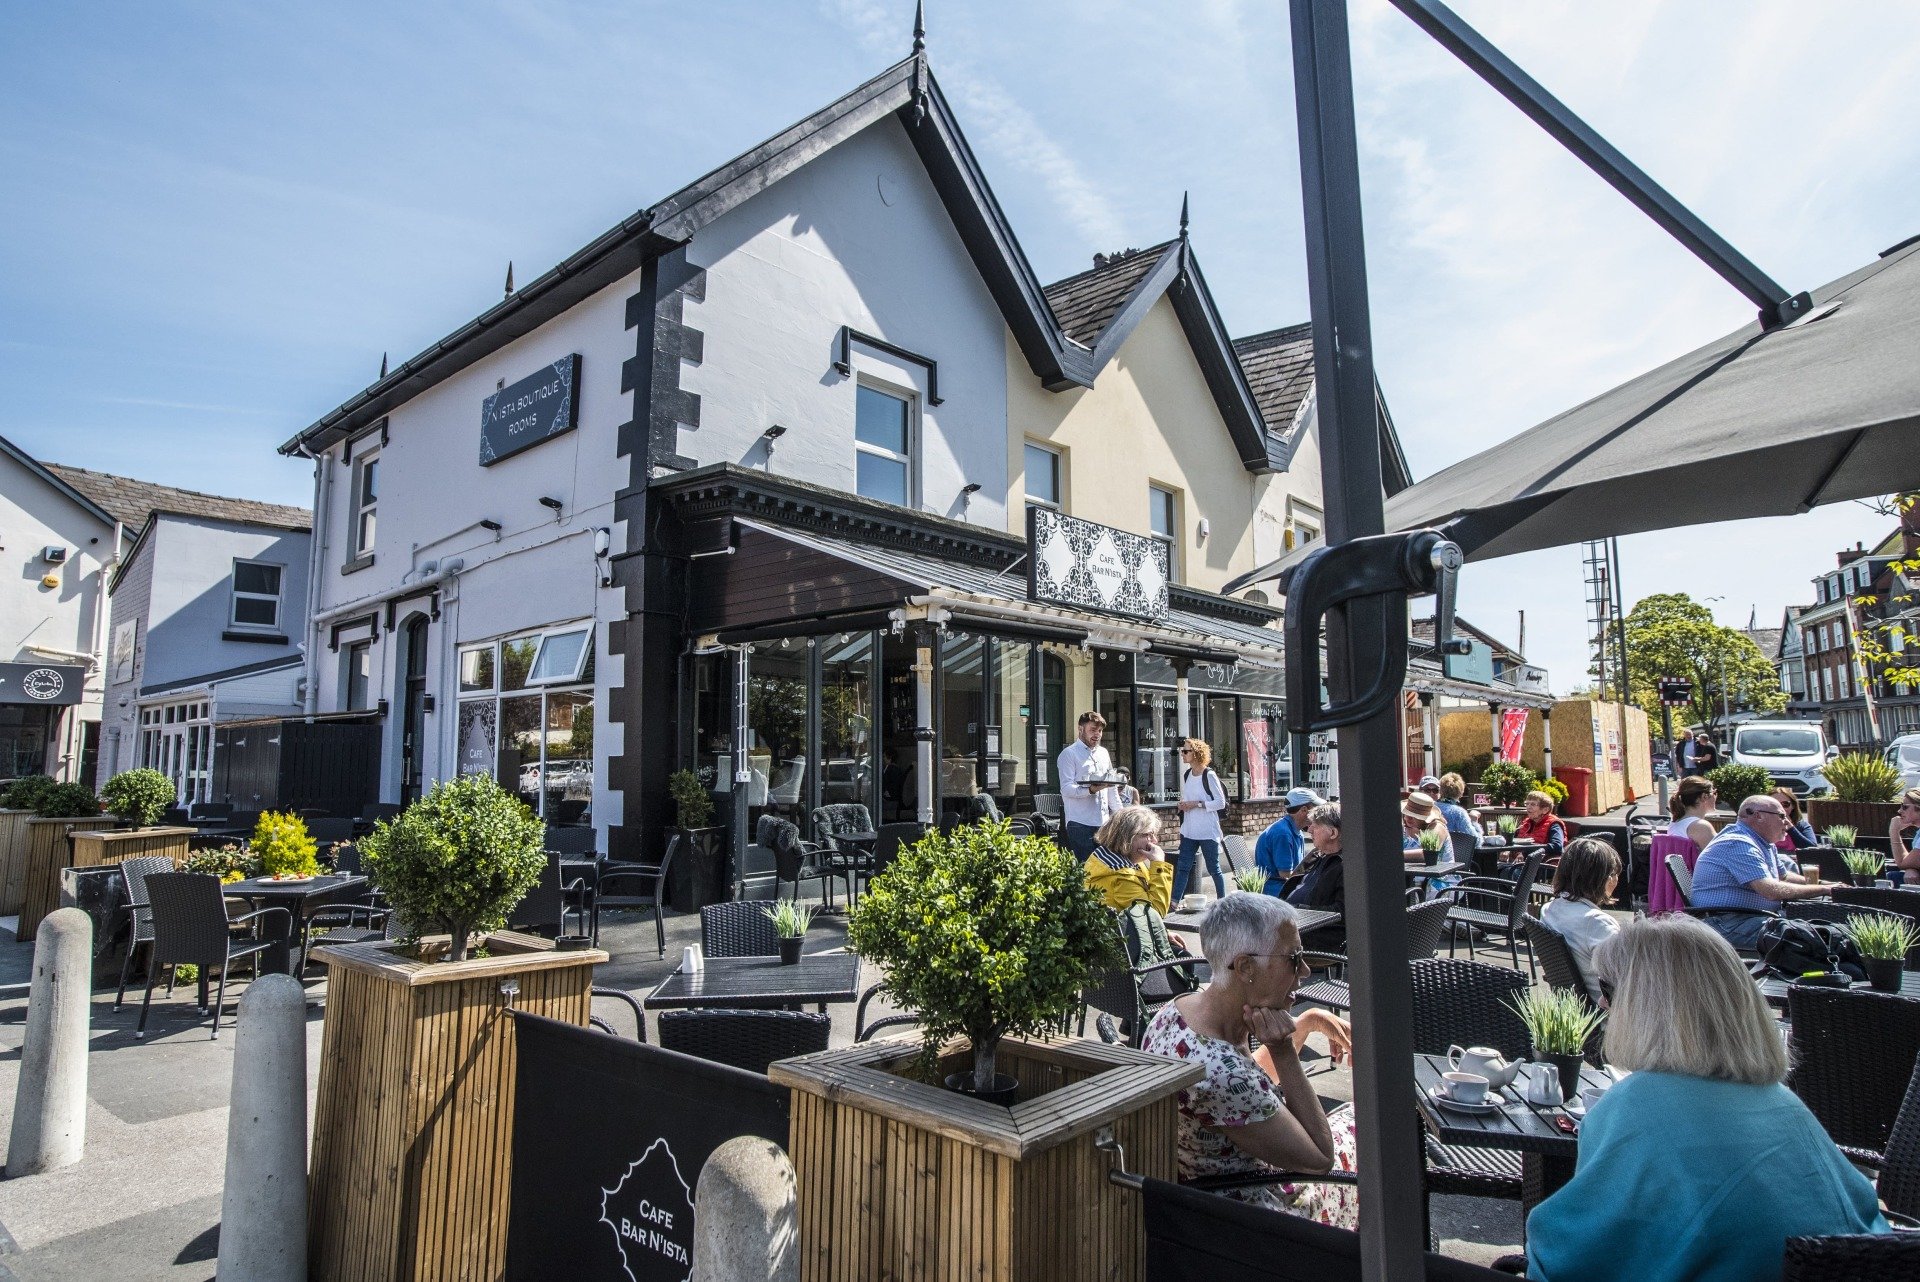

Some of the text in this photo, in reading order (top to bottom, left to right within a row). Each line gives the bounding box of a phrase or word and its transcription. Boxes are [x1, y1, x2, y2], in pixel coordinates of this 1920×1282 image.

[517, 379, 560, 411] BOUTIQUE
[508, 413, 537, 436] ROOMS
[1092, 564, 1105, 576] BAR
[1099, 553, 1115, 566] CAFE
[470, 748, 483, 759] CAFE
[640, 1199, 674, 1230] CAFE
[620, 1217, 689, 1265] BAR N'ISTA
